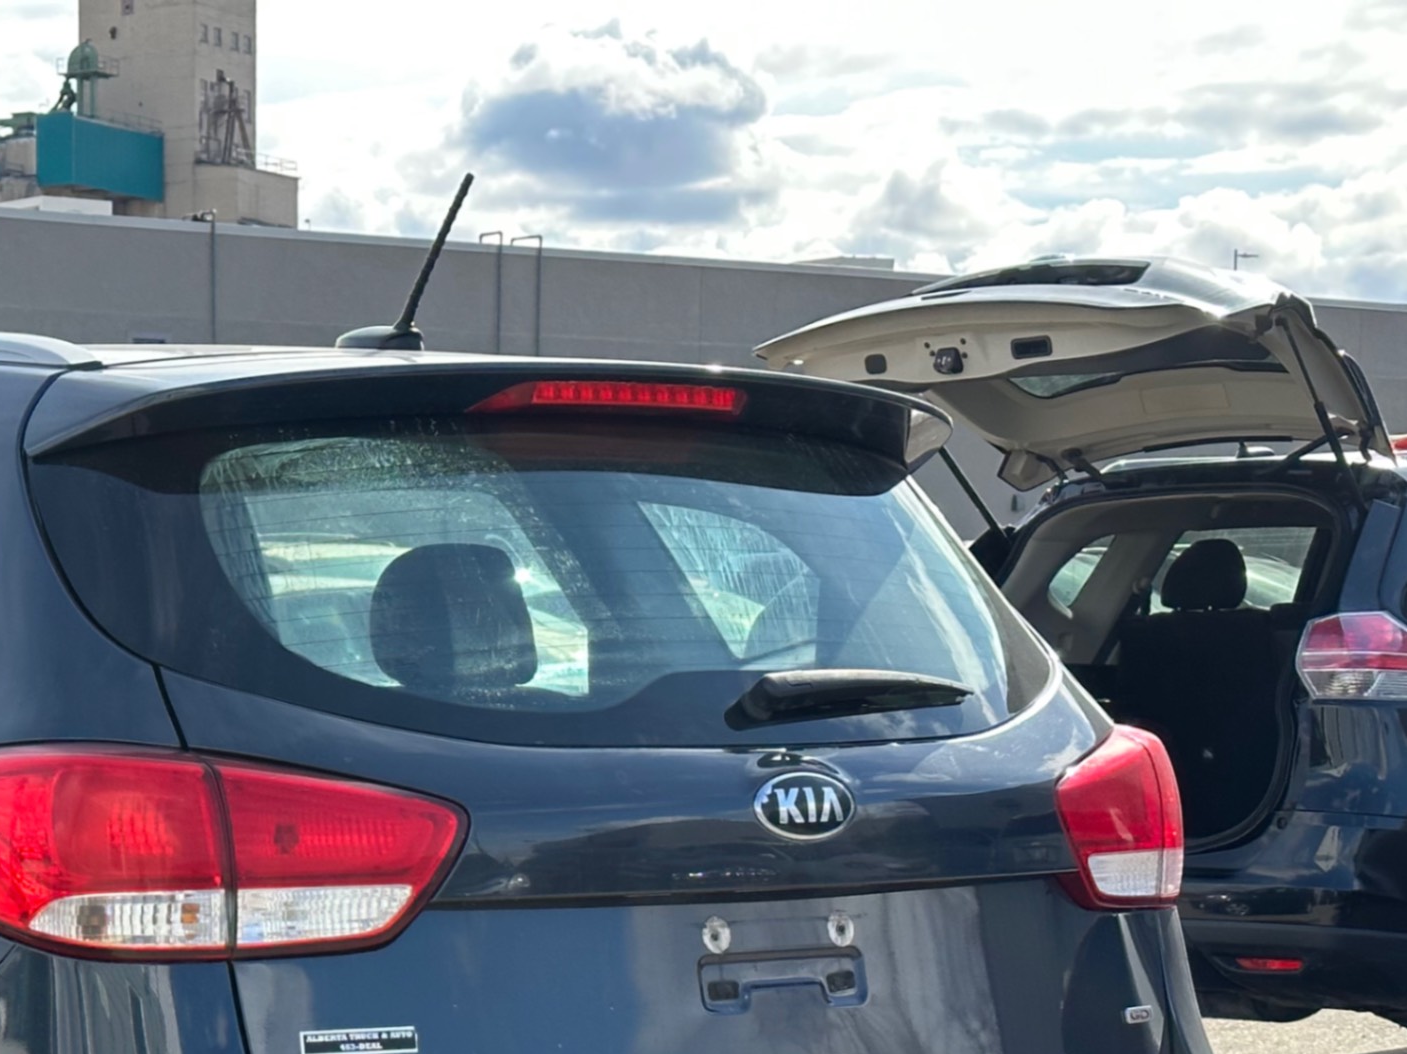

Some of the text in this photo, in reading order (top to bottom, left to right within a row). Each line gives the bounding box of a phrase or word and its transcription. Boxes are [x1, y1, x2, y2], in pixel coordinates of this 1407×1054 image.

[773, 786, 845, 825] KIA
[306, 1033, 348, 1043] ALBERTA
[349, 1032, 380, 1041] TRUCK
[390, 1031, 413, 1039] AUTO
